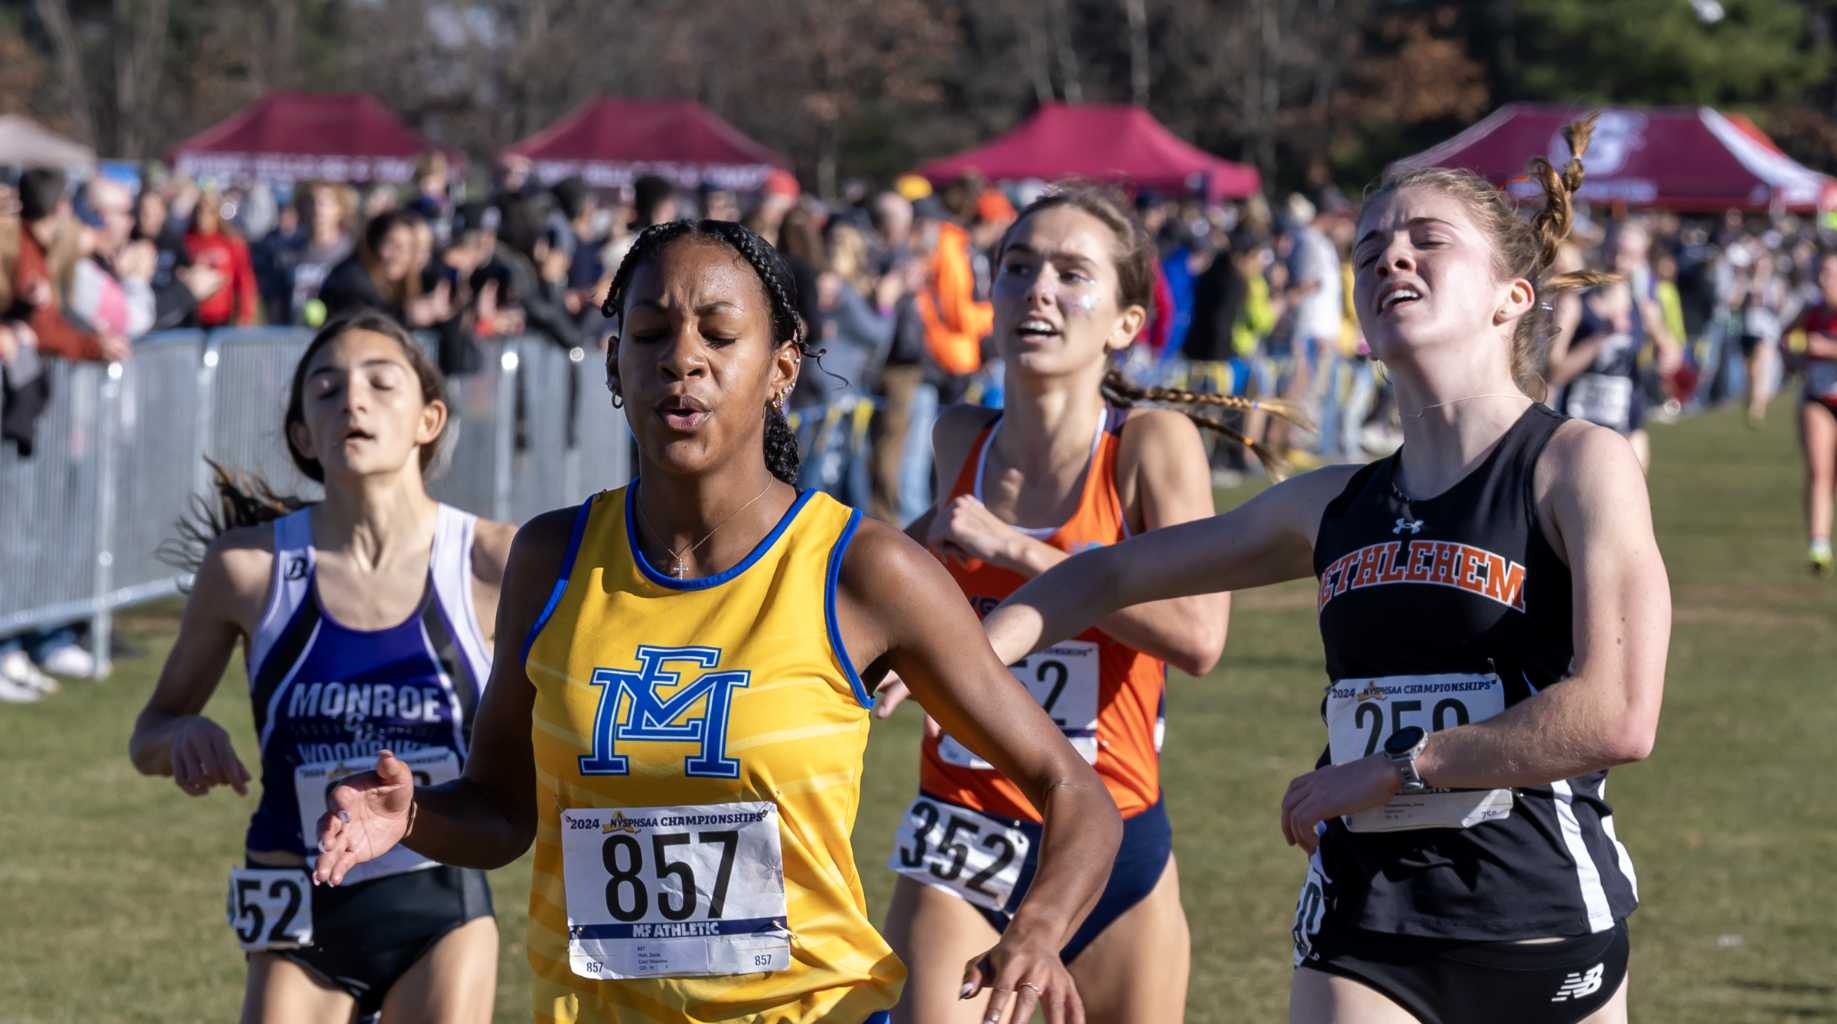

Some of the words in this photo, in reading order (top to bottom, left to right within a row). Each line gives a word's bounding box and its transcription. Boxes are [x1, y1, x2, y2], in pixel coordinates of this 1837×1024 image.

[1333, 687, 1356, 699] 2024
[1403, 681, 1491, 694] CHAMPIONSHIPS
[288, 682, 441, 722] MONROE
[570, 818, 600, 830] 2024
[661, 812, 763, 827] CHAMPIONSHIPS
[901, 801, 1015, 898] 352
[602, 830, 739, 922] 857
[632, 924, 651, 938] MF
[653, 922, 720, 937] ATHLETIC
[586, 961, 604, 973] 857
[754, 954, 772, 966] 857
